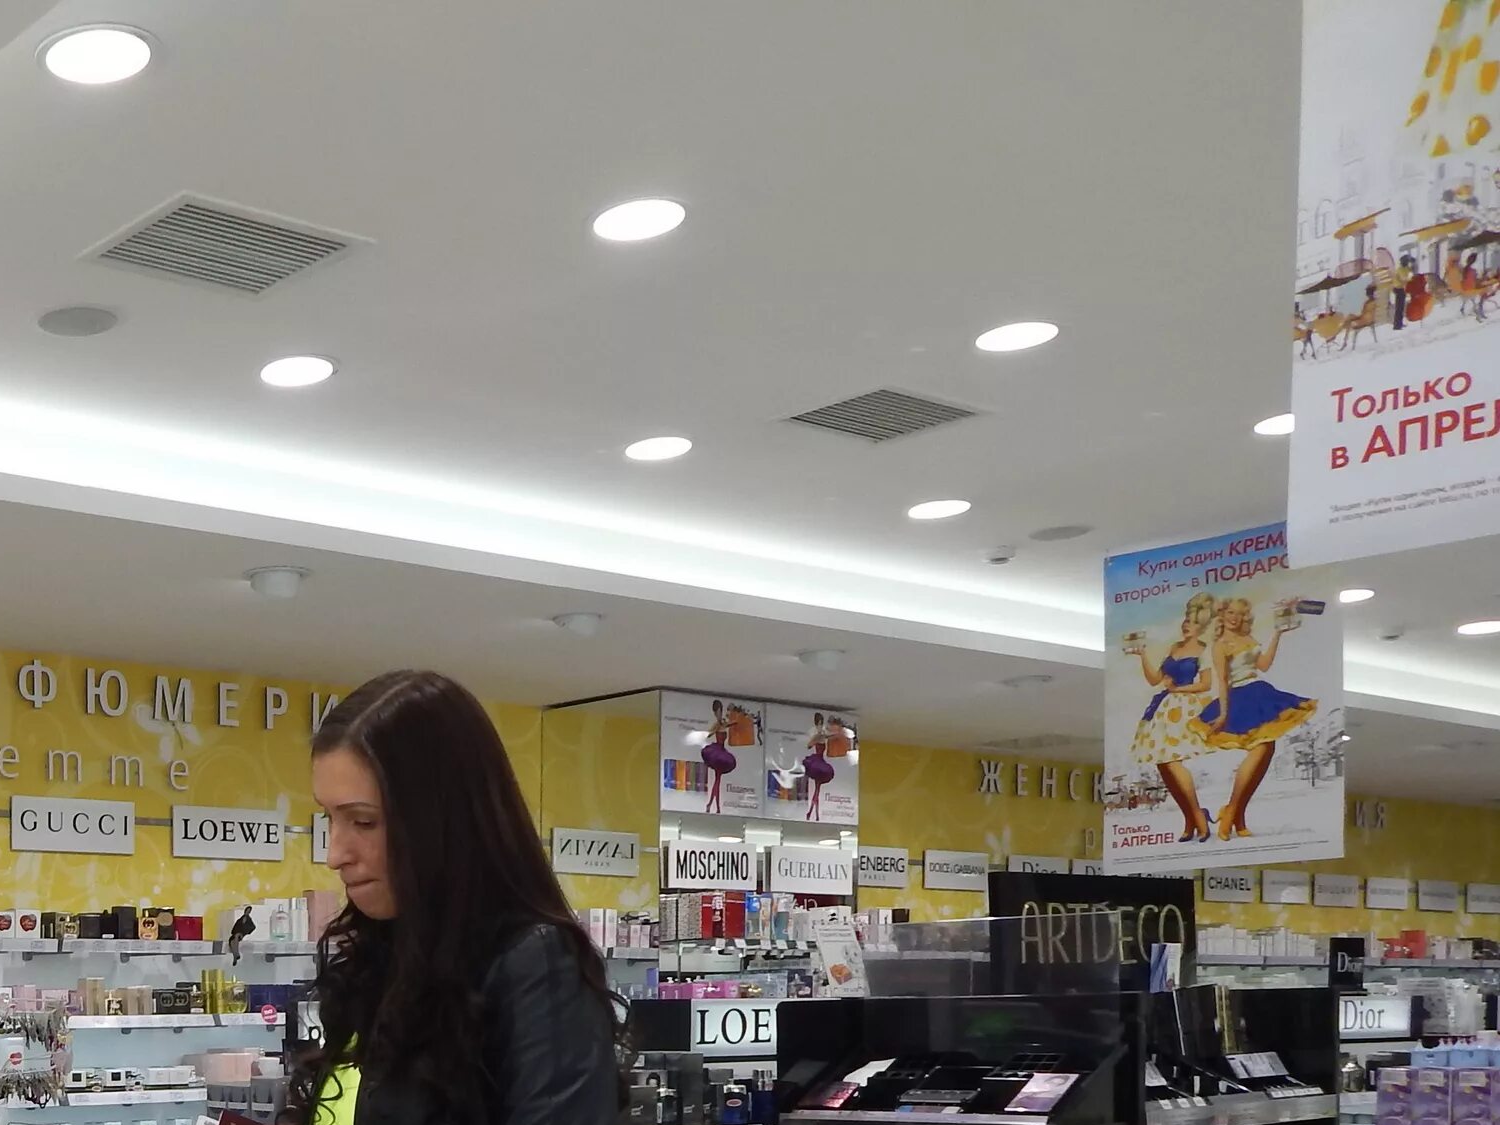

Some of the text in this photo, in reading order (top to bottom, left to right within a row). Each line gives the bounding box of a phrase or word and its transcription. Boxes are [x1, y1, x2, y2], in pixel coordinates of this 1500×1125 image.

[1331, 371, 1472, 424] Только
[1330, 444, 1350, 470] в
[1138, 558, 1178, 579] Купи
[1182, 549, 1224, 568] один
[1114, 579, 1172, 604] второй
[1191, 577, 1200, 588] в
[19, 810, 130, 837] GUCCI
[181, 818, 281, 846] LOEWE
[1112, 824, 1150, 836] Только
[1120, 832, 1175, 848] АПРЕЛЕ!
[675, 842, 750, 882] MOSCHINO
[777, 857, 850, 883] GUERLAIN
[859, 855, 906, 873] ENBERG
[1207, 877, 1252, 891] CHANEL
[1337, 951, 1364, 973] Dior
[696, 1007, 772, 1045] LOE
[1343, 1000, 1385, 1031] Dior
